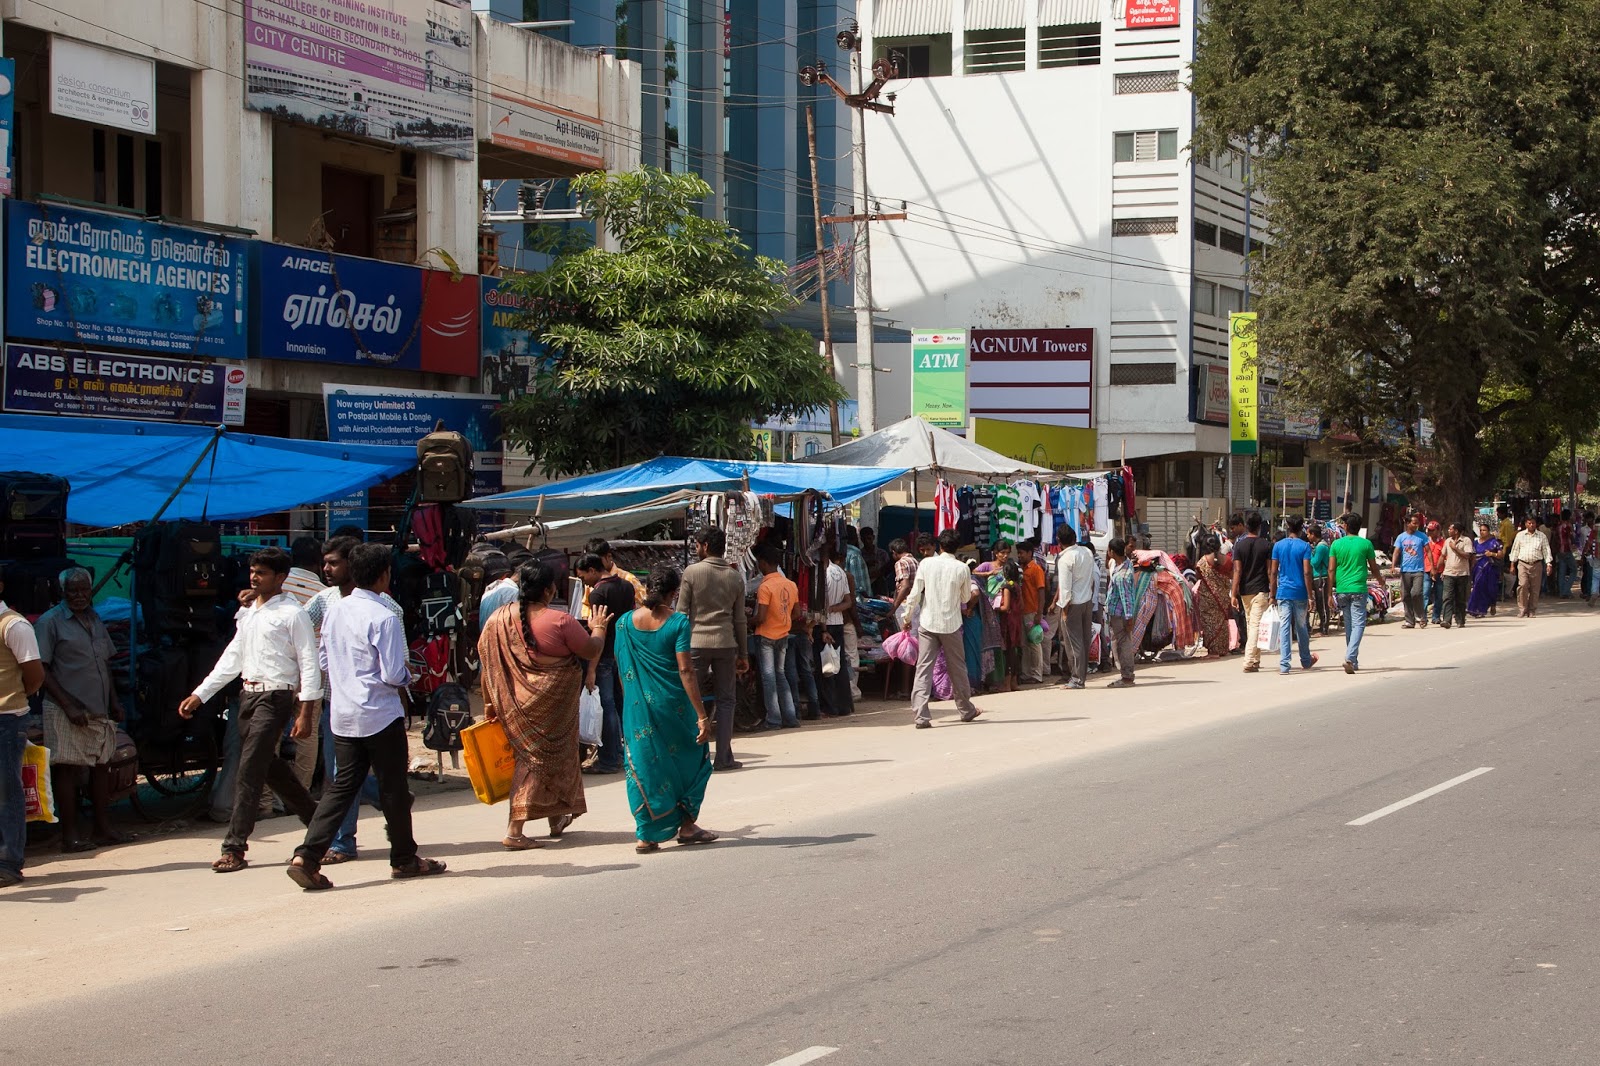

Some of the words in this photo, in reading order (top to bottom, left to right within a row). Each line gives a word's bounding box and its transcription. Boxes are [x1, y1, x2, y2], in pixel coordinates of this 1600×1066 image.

[320, 7, 331, 20] OF
[333, 12, 379, 34] EDUCATION
[367, 5, 407, 27] INSTITUTE
[254, 26, 286, 48] CITY
[291, 37, 346, 65] CENTRE
[257, 6, 275, 21] KSR
[300, 19, 307, 29] &
[309, 21, 341, 40] HIGHER
[344, 31, 390, 54] SECONDARY
[393, 46, 422, 63] SCHOOL
[57, 73, 86, 90] design
[88, 82, 131, 98] consortium
[57, 87, 90, 99] architects
[91, 93, 97, 101] &
[98, 97, 130, 109] engineers
[519, 128, 544, 140] Information
[543, 133, 566, 147] Technology
[566, 139, 583, 150] Solution
[583, 143, 600, 154] Provider
[556, 119, 569, 136] Apt
[571, 123, 600, 145] Infoway
[26, 245, 151, 284] ELECTROMECH
[155, 264, 230, 295] AGENCIES
[281, 256, 335, 275] AIRCEL
[283, 284, 402, 335] ஏர்செல்
[36, 317, 52, 327] Shop
[54, 319, 64, 327] No.
[76, 322, 90, 330] Door
[92, 324, 102, 332] No.
[117, 326, 125, 334] Dr.
[126, 328, 152, 337] Nanjappa
[153, 330, 169, 340] Road,
[169, 332, 200, 342] Coimbatore
[77, 331, 100, 340] Mobile
[286, 341, 327, 356] Innovision
[1042, 339, 1087, 353] Towers
[17, 353, 65, 372] ABS
[73, 357, 214, 385] ELECTRONICS
[918, 352, 960, 369] ATM
[23, 389, 47, 398] Branded
[47, 391, 62, 400] UPS,
[83, 394, 109, 403] batteries,
[126, 397, 139, 405] UPS,
[140, 398, 153, 406] Solar
[194, 402, 216, 410] Batteries
[336, 399, 352, 408] Now
[353, 401, 373, 410] enjoy
[373, 400, 405, 410] Unlimited
[405, 401, 416, 410] 3G
[348, 411, 378, 421] Postpaid
[379, 412, 401, 421] Mobile
[402, 412, 408, 421] &
[408, 412, 432, 422] Dongle
[338, 425, 351, 433] with
[352, 425, 369, 433] Aircel
[340, 499, 362, 507] Postpaid
